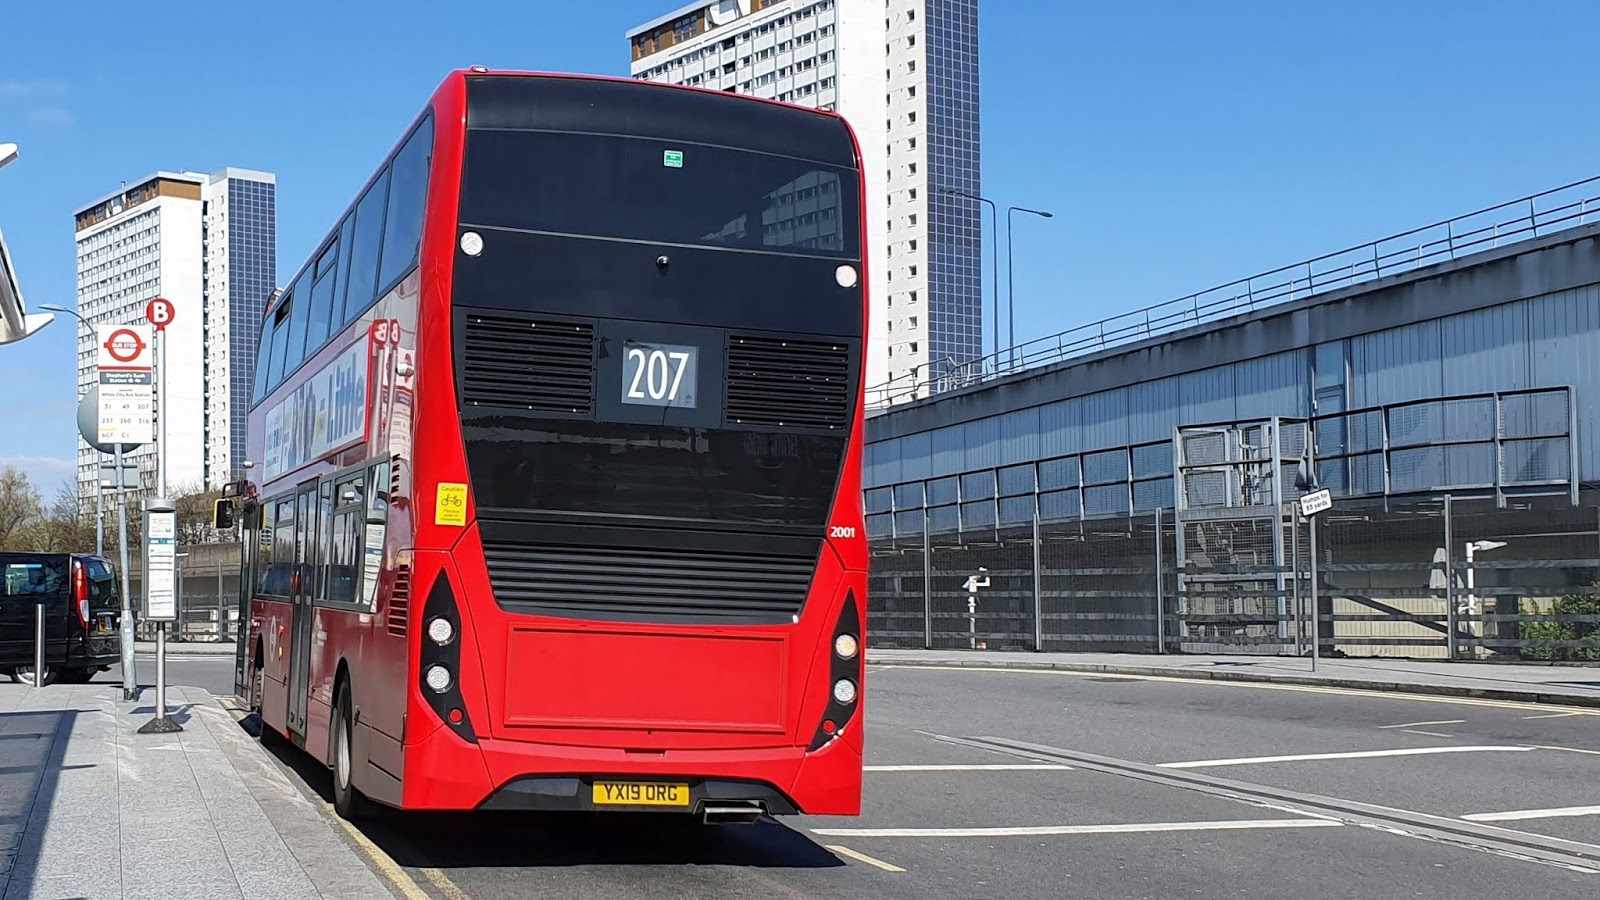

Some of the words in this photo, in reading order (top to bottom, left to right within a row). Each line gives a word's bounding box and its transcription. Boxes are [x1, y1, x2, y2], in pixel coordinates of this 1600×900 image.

[153, 301, 169, 322] B
[627, 348, 690, 400] 207
[1314, 500, 1328, 510] yards
[830, 526, 855, 538] 2001
[604, 783, 640, 800] YX19
[646, 784, 677, 801] ORG
